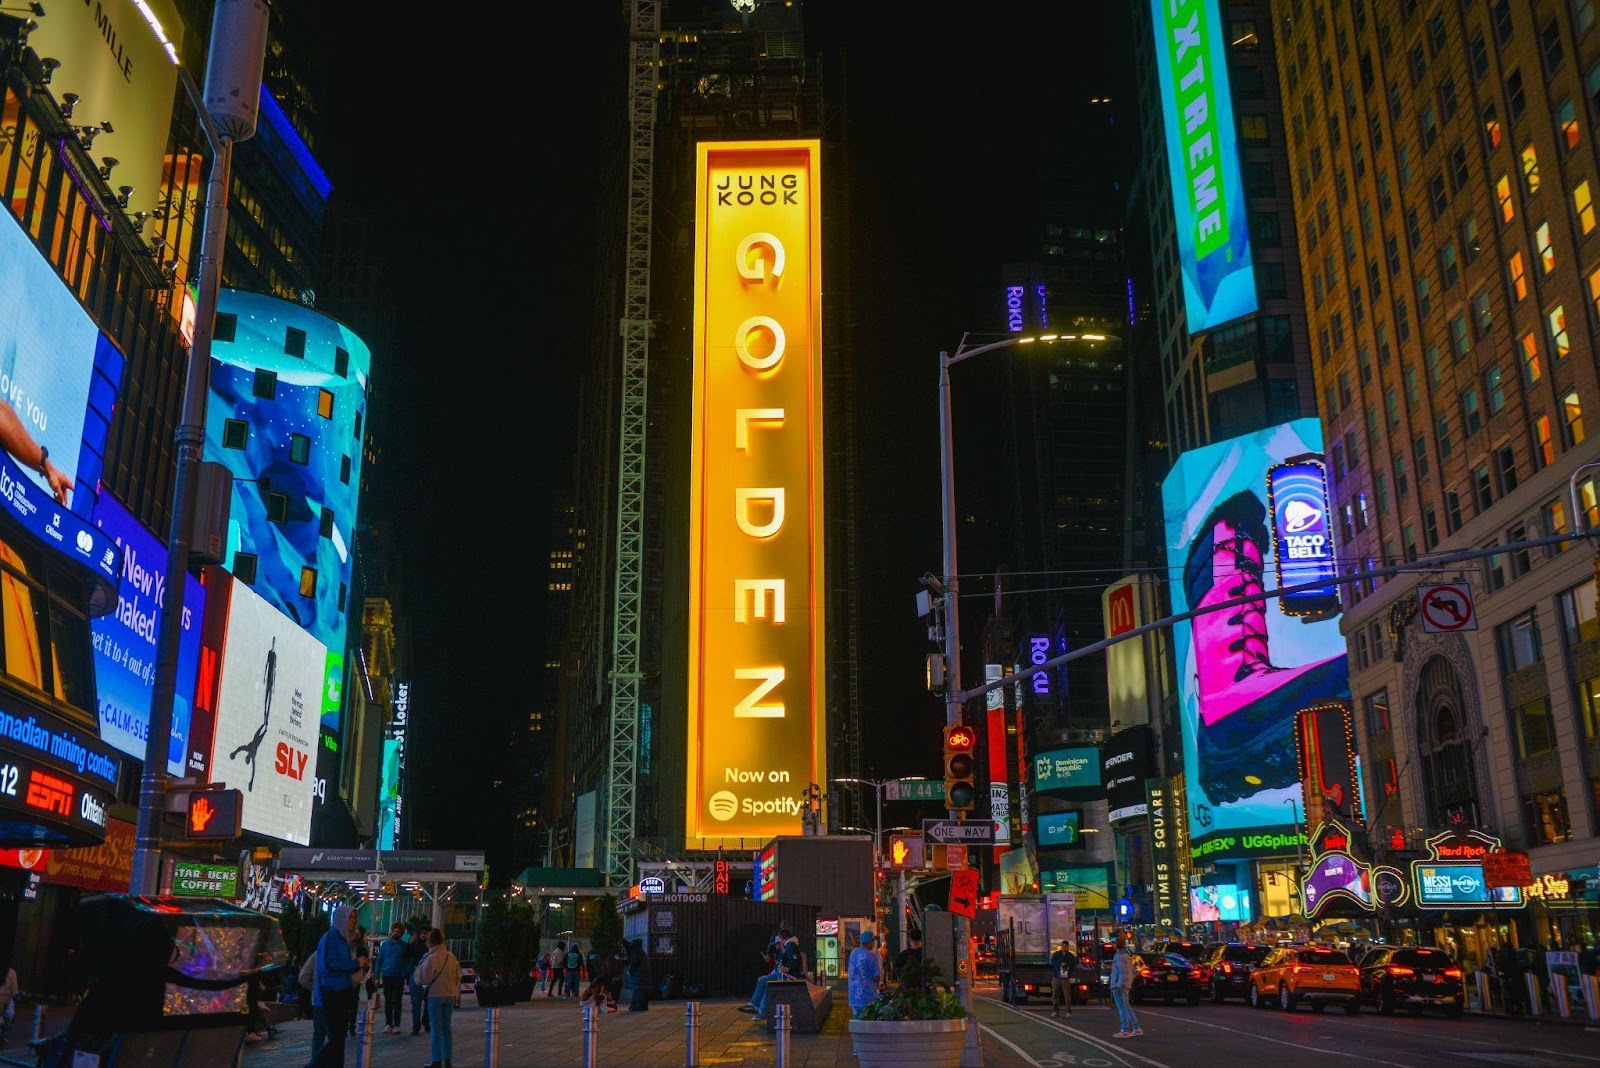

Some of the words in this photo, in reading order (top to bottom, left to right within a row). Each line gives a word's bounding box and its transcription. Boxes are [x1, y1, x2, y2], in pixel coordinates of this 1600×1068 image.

[95, 1, 133, 84] MILLE
[717, 174, 797, 190] JUNG
[718, 190, 798, 206] KOOK
[0, 369, 24, 409] OVE
[26, 396, 48, 432] YOU
[735, 231, 785, 718] GOLDEN
[1284, 535, 1325, 547] TACO
[1288, 546, 1326, 559] BELL
[122, 543, 153, 597] New
[394, 683, 408, 726] Locker
[50, 731, 87, 773] mining
[275, 741, 308, 781] SLY
[1055, 758, 1088, 766] Dominican
[1056, 764, 1082, 773] Republic
[725, 768, 764, 783] Now
[768, 770, 790, 783] on
[1, 763, 19, 796] 12
[26, 770, 73, 817] ESPN
[901, 784, 911, 797] W
[917, 784, 932, 797] 44
[741, 797, 801, 816] Spotify
[1152, 789, 1167, 848] SQUARE
[934, 828, 955, 837] ONE
[964, 828, 986, 837] WAY
[1242, 833, 1309, 850] UGGplush
[1438, 846, 1463, 856] Hard
[181, 880, 222, 891] COFFEE
[715, 861, 725, 895] BAR
[1423, 876, 1452, 888] MESSI
[1157, 864, 1171, 909] TIMES
[664, 894, 708, 903] HOTDOGS
[1161, 918, 1172, 926] 3
